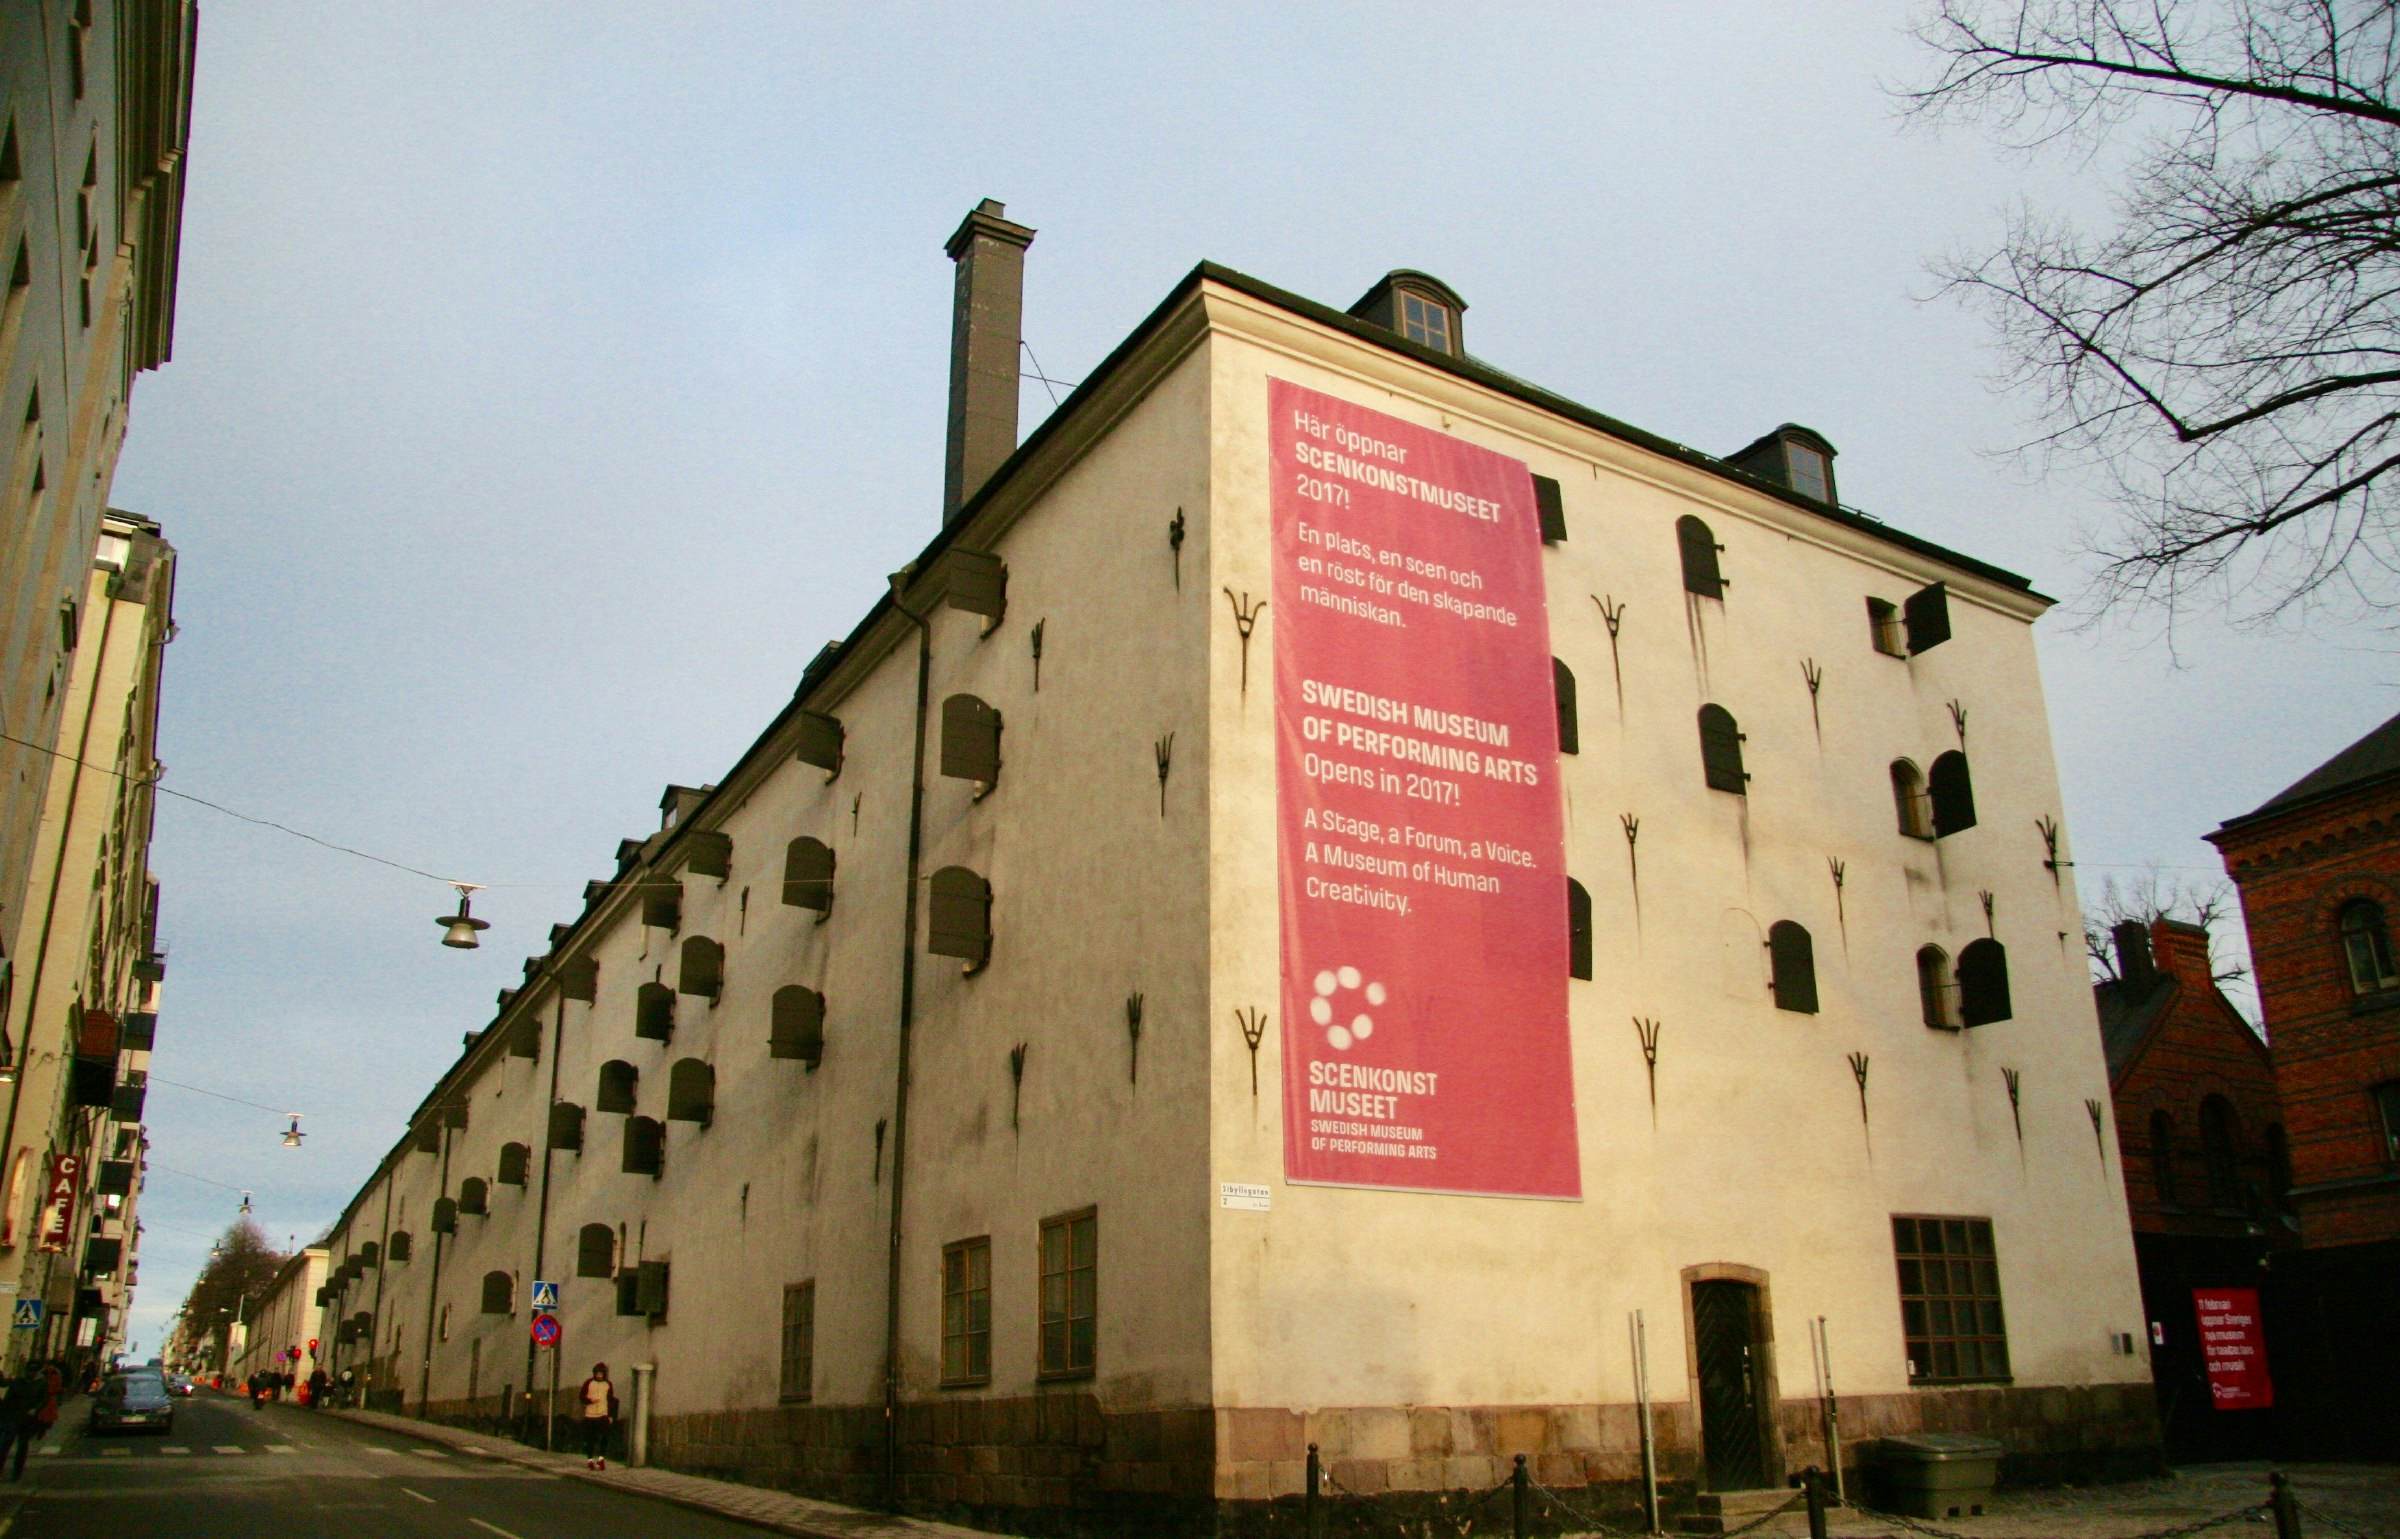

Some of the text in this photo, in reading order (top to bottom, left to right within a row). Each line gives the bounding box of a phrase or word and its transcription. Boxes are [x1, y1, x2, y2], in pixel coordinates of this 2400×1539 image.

[1294, 409, 1408, 464] Här öppnar
[1295, 441, 1501, 523] SCENKONSTMUSEET
[1296, 474, 1350, 510] 2017!
[1298, 522, 1483, 591] En plats, en scen och
[1298, 556, 1518, 627] en röst för den skapande
[1300, 584, 1407, 629] människan.
[1302, 678, 1509, 747] SWEDISH MUSEUM
[1302, 716, 1538, 787] OF PERFORMING ARTS
[1304, 752, 1461, 806] Opens in 2017!
[1304, 807, 1537, 869] A Stage, a Forum, a Voice.
[1304, 842, 1500, 894] A Museum of Human
[1306, 876, 1412, 918] Creativity.
[1309, 1060, 1438, 1096] SCENKONST
[1310, 1088, 1398, 1120] MUSEET
[1310, 1118, 1423, 1140] SWEDISH MUSEUM
[1311, 1136, 1438, 1160] OF PERFORMING ARTS
